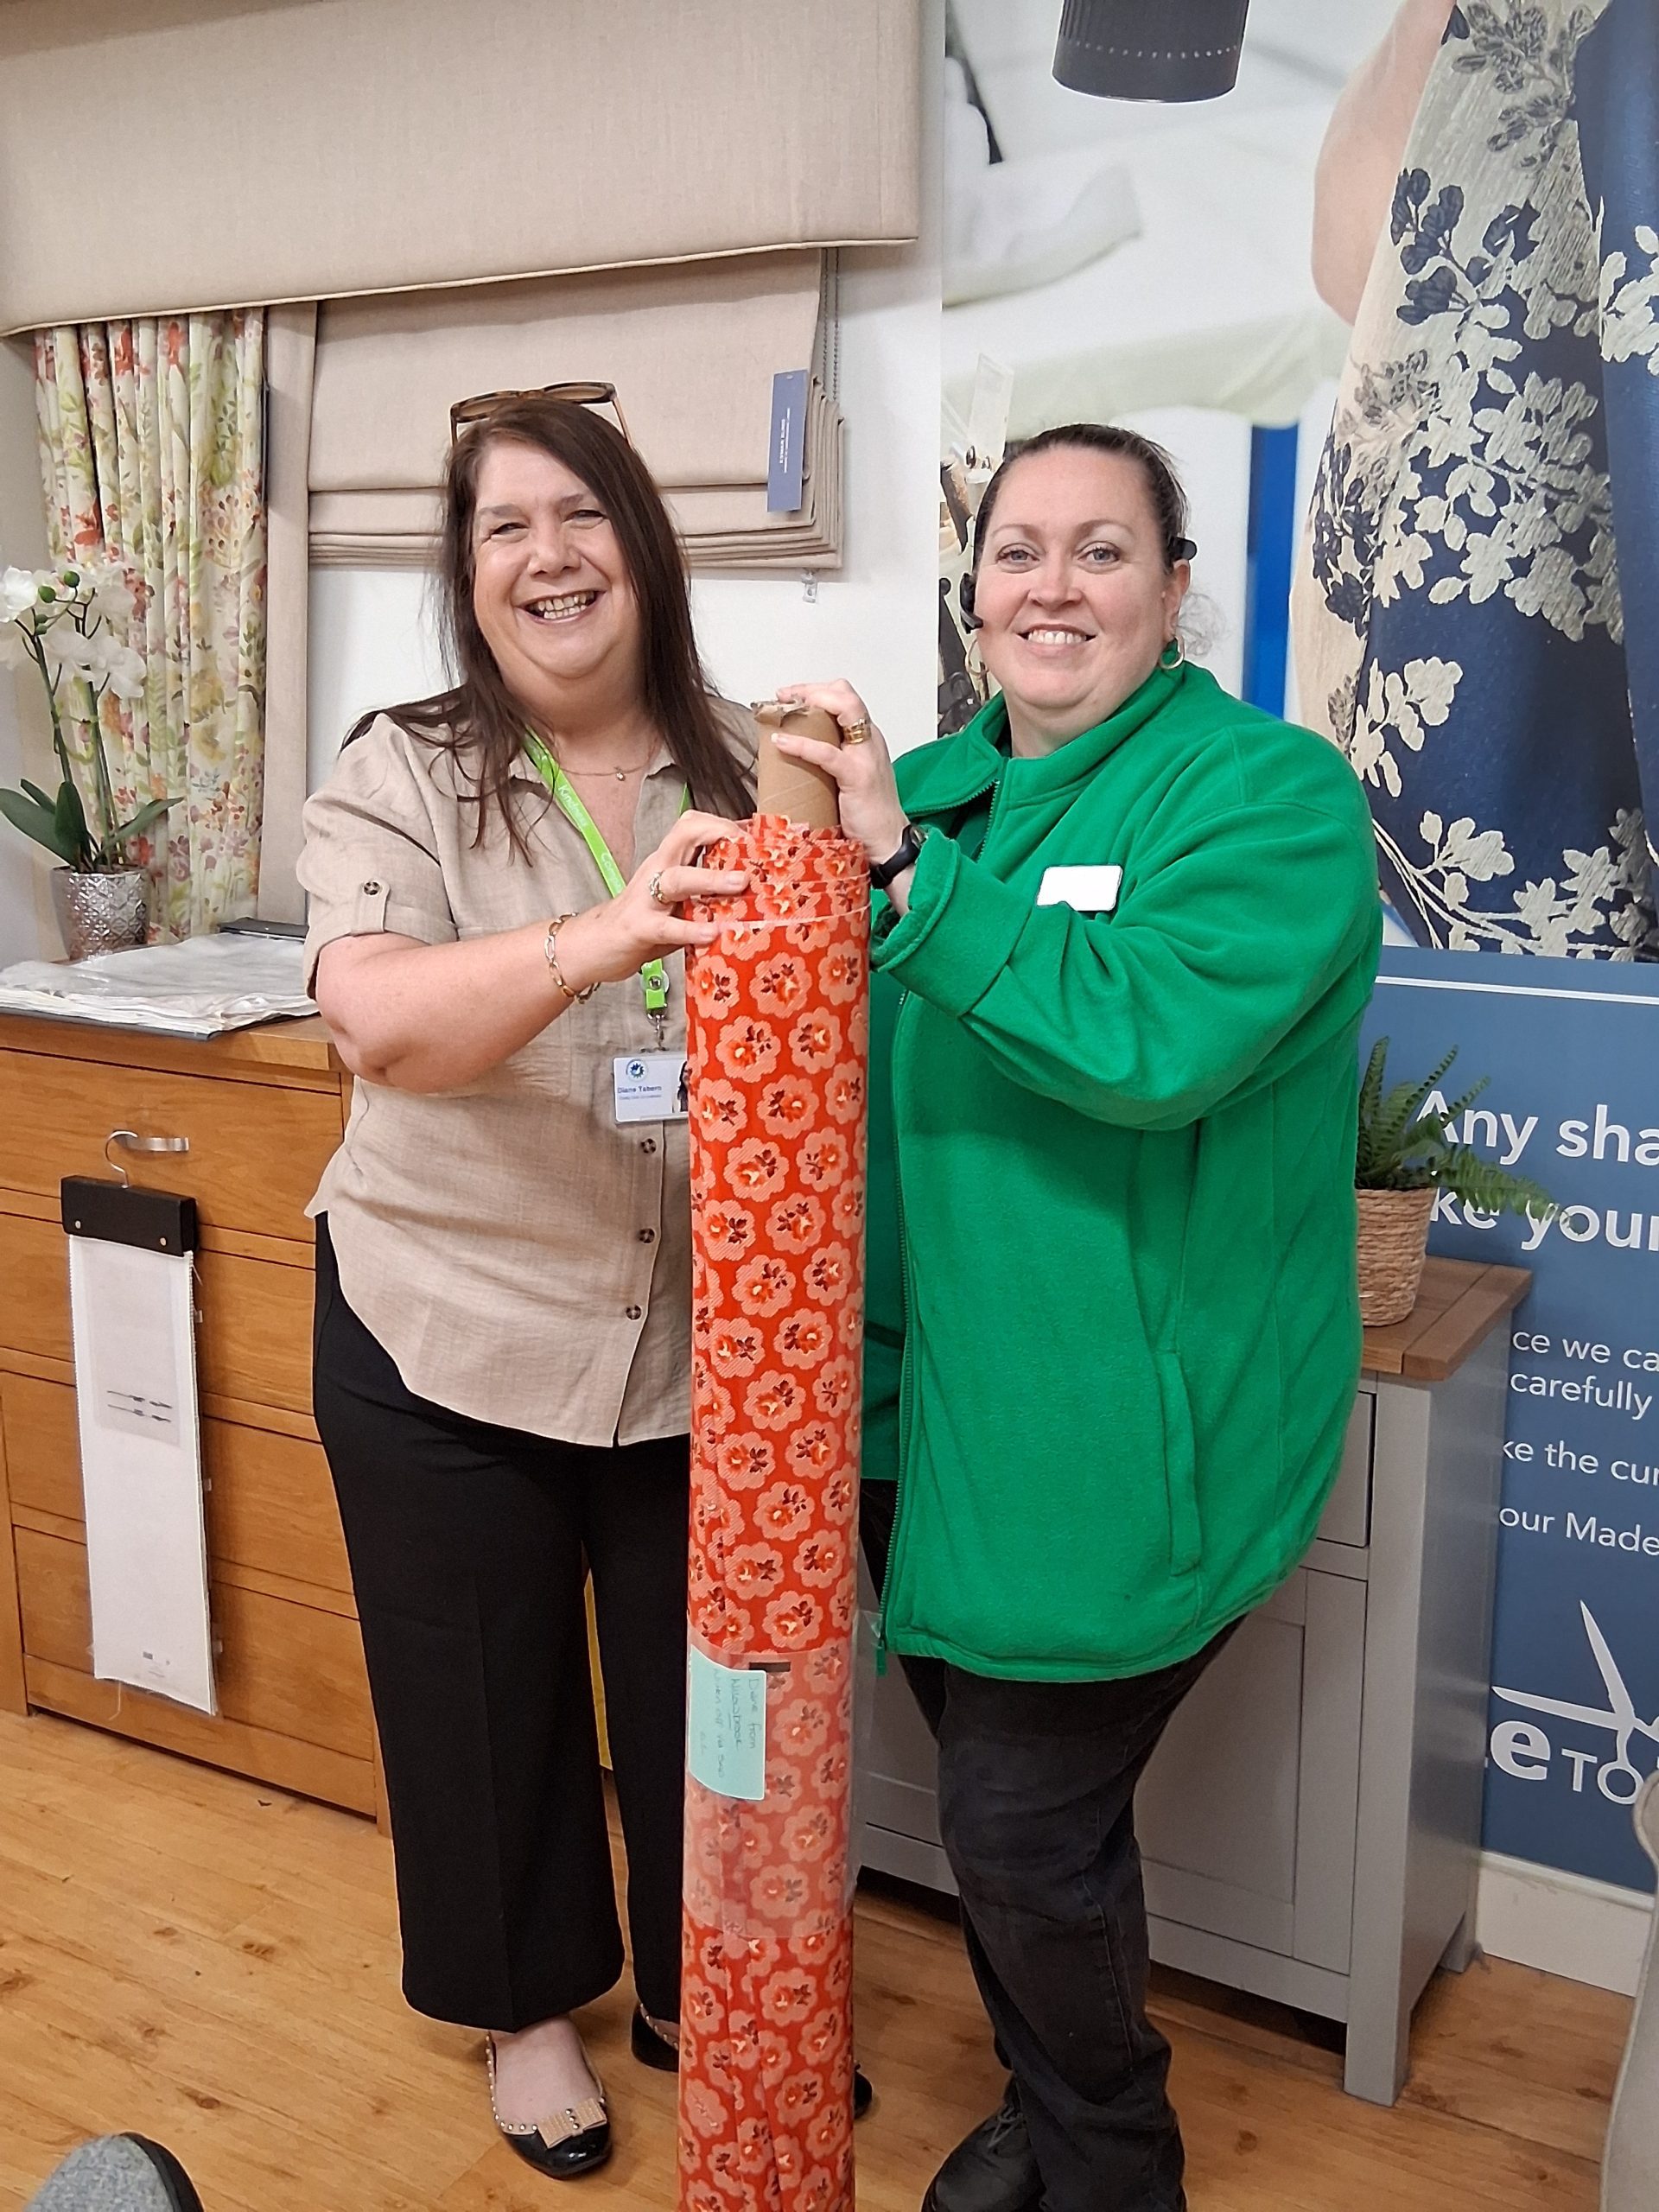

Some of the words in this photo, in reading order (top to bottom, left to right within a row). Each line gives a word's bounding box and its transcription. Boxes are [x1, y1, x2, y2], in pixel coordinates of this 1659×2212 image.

[1416, 1090, 1538, 1165] Any
[1556, 1104, 1659, 1166] sha
[1512, 1332, 1550, 1354] ce
[1562, 1339, 1611, 1363] we
[1624, 1349, 1659, 1372] ca
[1510, 1373, 1652, 1421] carefully
[1544, 1440, 1599, 1474] the
[1499, 1508, 1555, 1534] our
[1566, 1512, 1659, 1555] Made
[1488, 1720, 1551, 1780] e
